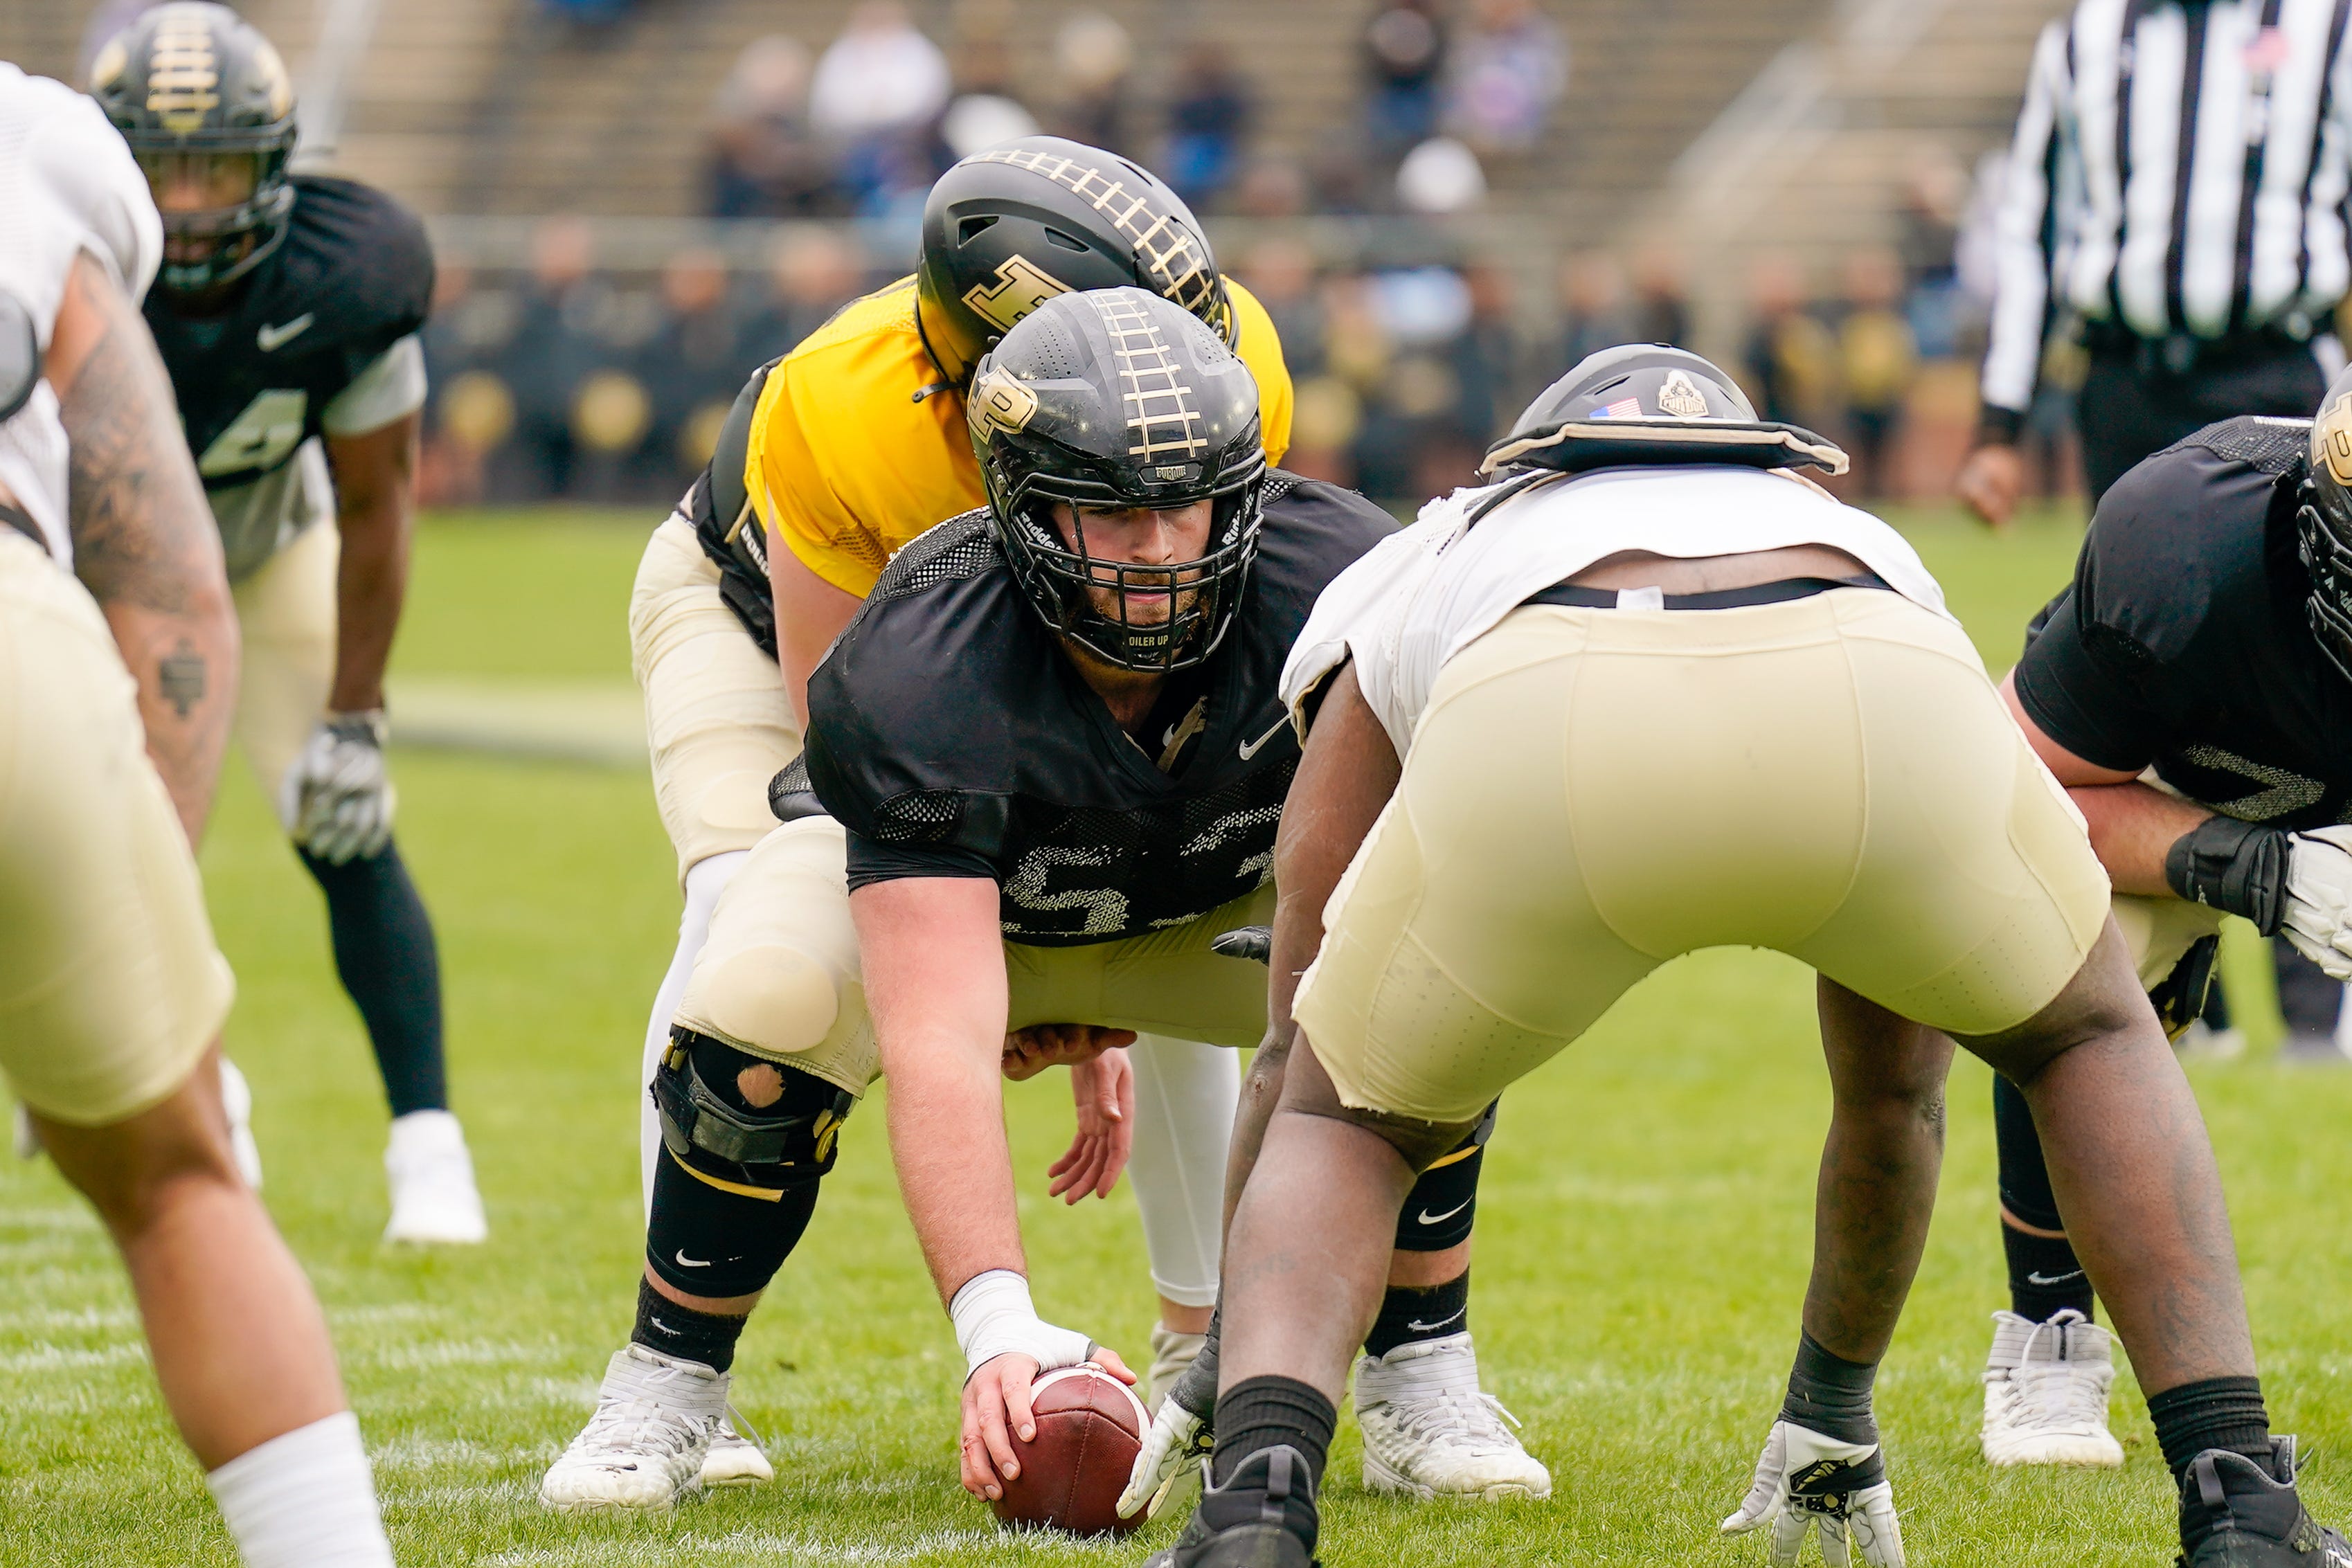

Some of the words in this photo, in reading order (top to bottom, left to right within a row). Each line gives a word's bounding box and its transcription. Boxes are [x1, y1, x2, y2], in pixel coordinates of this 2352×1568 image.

[1156, 465, 1186, 481] PURDUE
[740, 523, 770, 578] DOUG
[1122, 636, 1155, 646] OILER
[1157, 635, 1169, 645] UP
